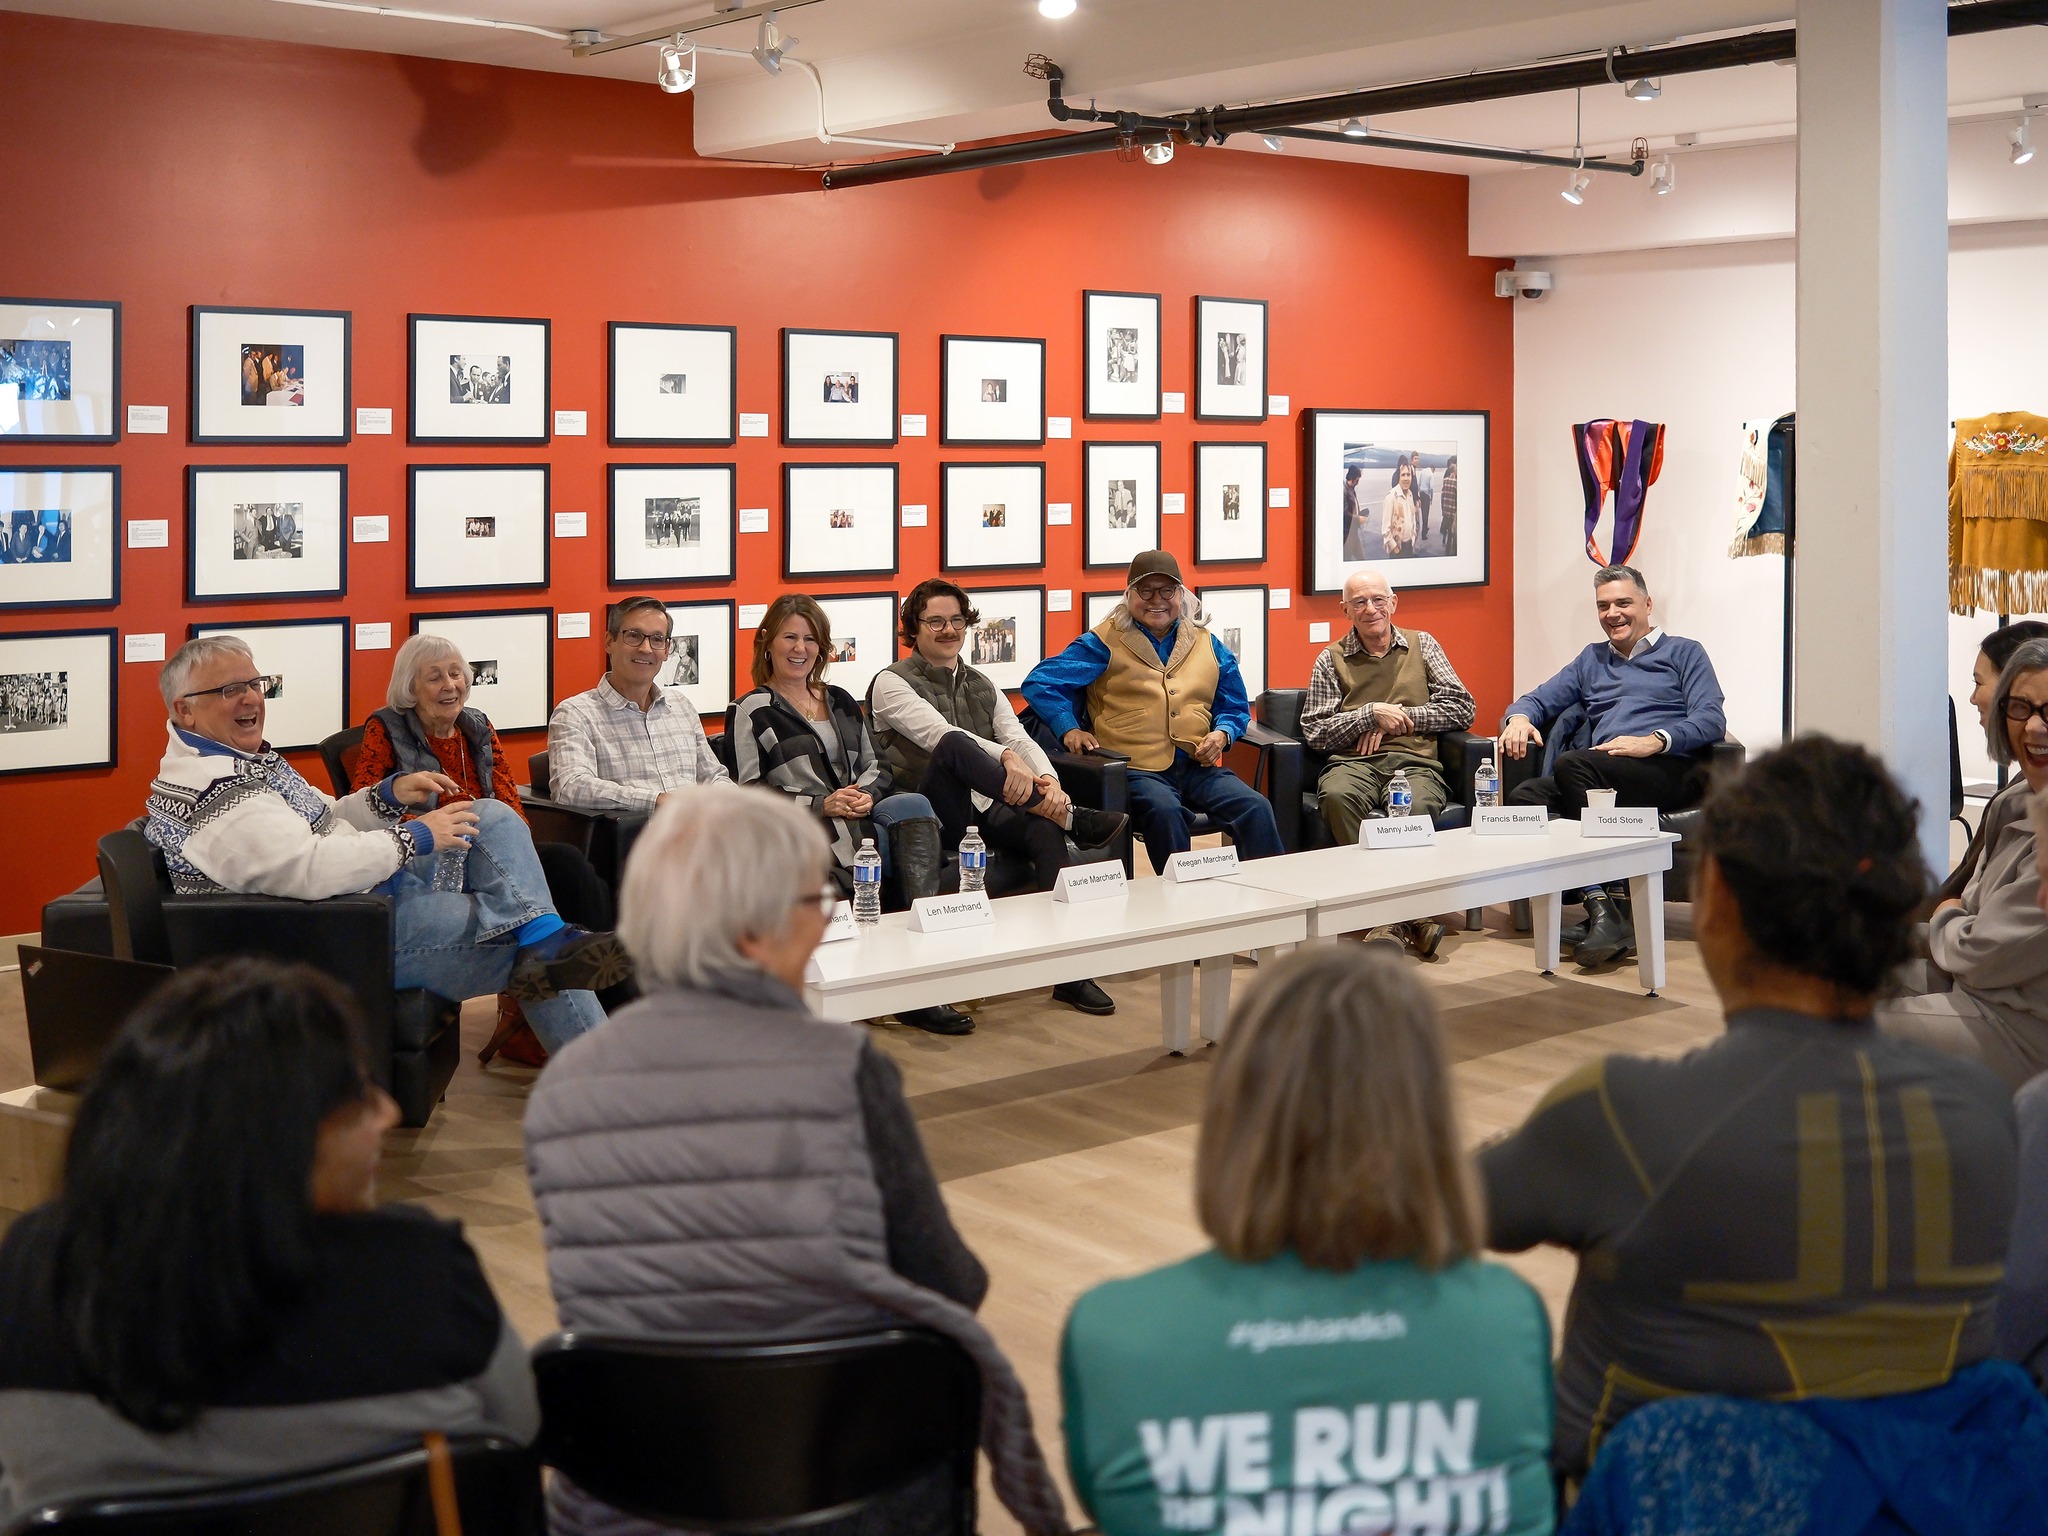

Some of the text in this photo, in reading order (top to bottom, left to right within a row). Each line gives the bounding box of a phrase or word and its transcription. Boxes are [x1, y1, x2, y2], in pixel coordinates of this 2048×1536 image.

[1481, 815, 1541, 823] Francis Barnett
[1598, 816, 1643, 824] Todd Stone
[1377, 824, 1423, 835] Manny Jules
[1177, 853, 1234, 869] Keegan Marchand
[1068, 872, 1122, 888] Laurie Marchand
[926, 902, 982, 917] Len Marchand
[1139, 1399, 1479, 1493] WE RUN
[1224, 1467, 1511, 1536] NIGHT!
